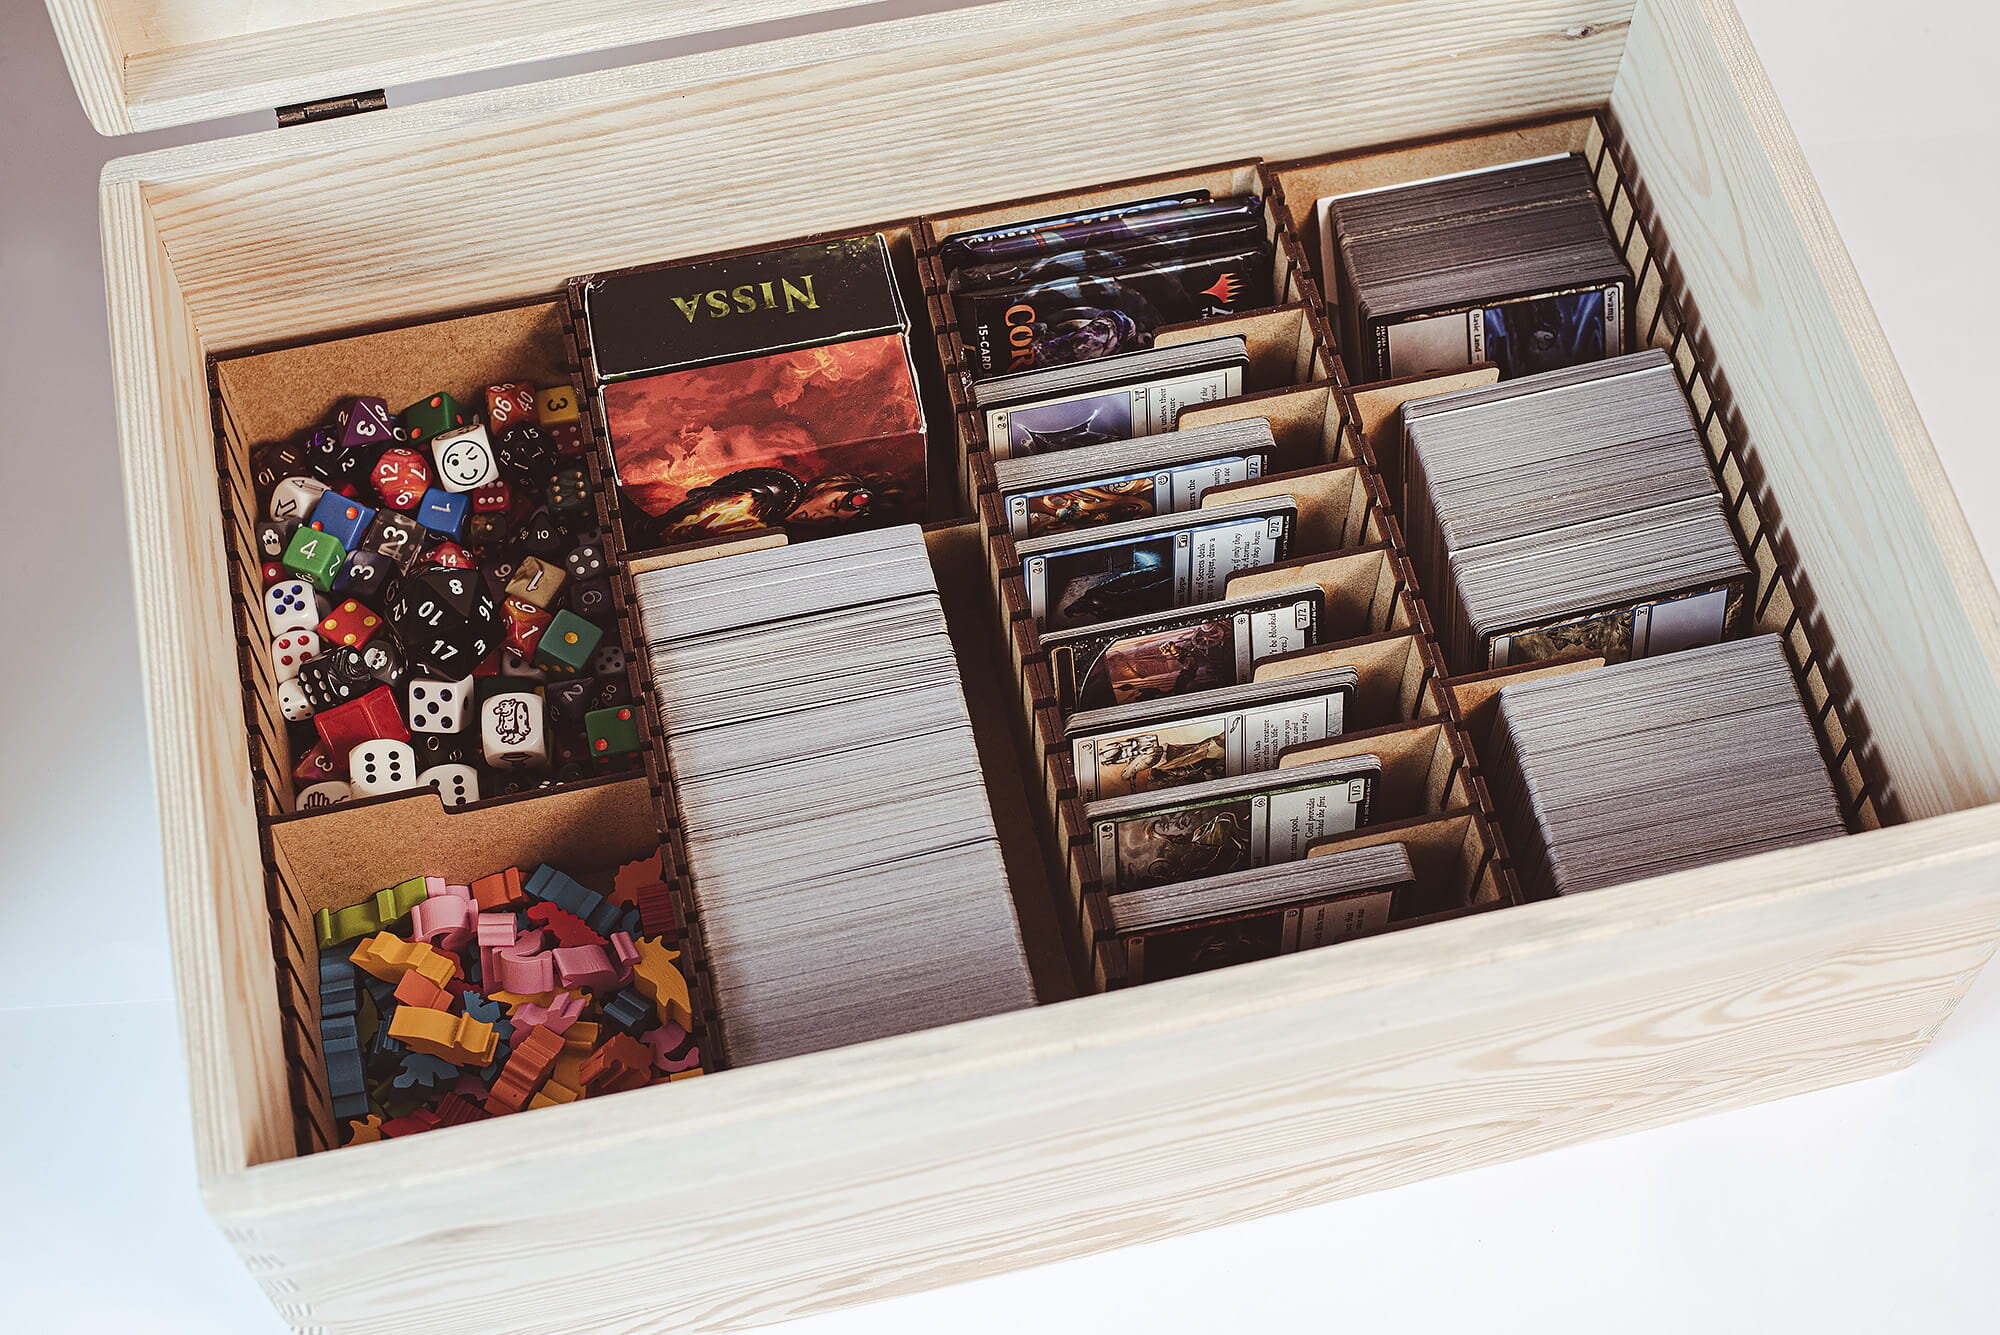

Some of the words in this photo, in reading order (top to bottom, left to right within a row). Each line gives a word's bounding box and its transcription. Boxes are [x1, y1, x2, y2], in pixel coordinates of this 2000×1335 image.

[670, 274, 821, 324] NISSA
[1606, 291, 1616, 322] Swamp
[1472, 313, 1481, 332] Basic
[977, 324, 992, 370] 15-CARD
[1473, 334, 1482, 352] Land
[1159, 388, 1167, 404] their
[547, 397, 568, 412] 3
[356, 420, 376, 437] 3
[522, 427, 539, 440] 15
[321, 437, 335, 453] 3
[380, 461, 399, 484] 12
[410, 467, 426, 481] 7
[1249, 462, 1258, 475] 2/2
[1187, 479, 1196, 490] the
[537, 530, 550, 540] 10
[1270, 521, 1280, 533] 2/2
[383, 526, 408, 546] 3
[1232, 532, 1242, 545] they
[300, 539, 319, 560] 4
[1198, 543, 1206, 558] deals
[1207, 543, 1216, 558] draw
[1233, 546, 1241, 558] only
[1252, 547, 1261, 558] they
[329, 554, 341, 577] 2
[440, 554, 457, 567] 14
[1206, 558, 1216, 578] player,
[350, 564, 375, 581] 3
[1196, 560, 1205, 581] Secrets
[448, 579, 464, 595] 8
[526, 570, 544, 592] 1
[418, 600, 444, 626] 10
[1298, 608, 1307, 622] 2/2
[521, 625, 539, 639] 1
[1268, 613, 1277, 638] blocked
[430, 639, 459, 661] 17
[473, 639, 487, 656] 3
[1269, 639, 1278, 647] be
[562, 683, 584, 702] 2
[1300, 712, 1309, 724] play
[315, 755, 334, 772] 3
[1351, 784, 1361, 796] 1/3
[1306, 798, 1315, 821] provides
[1317, 796, 1327, 808] first
[1317, 809, 1326, 818] the
[1290, 815, 1300, 832] pool.
